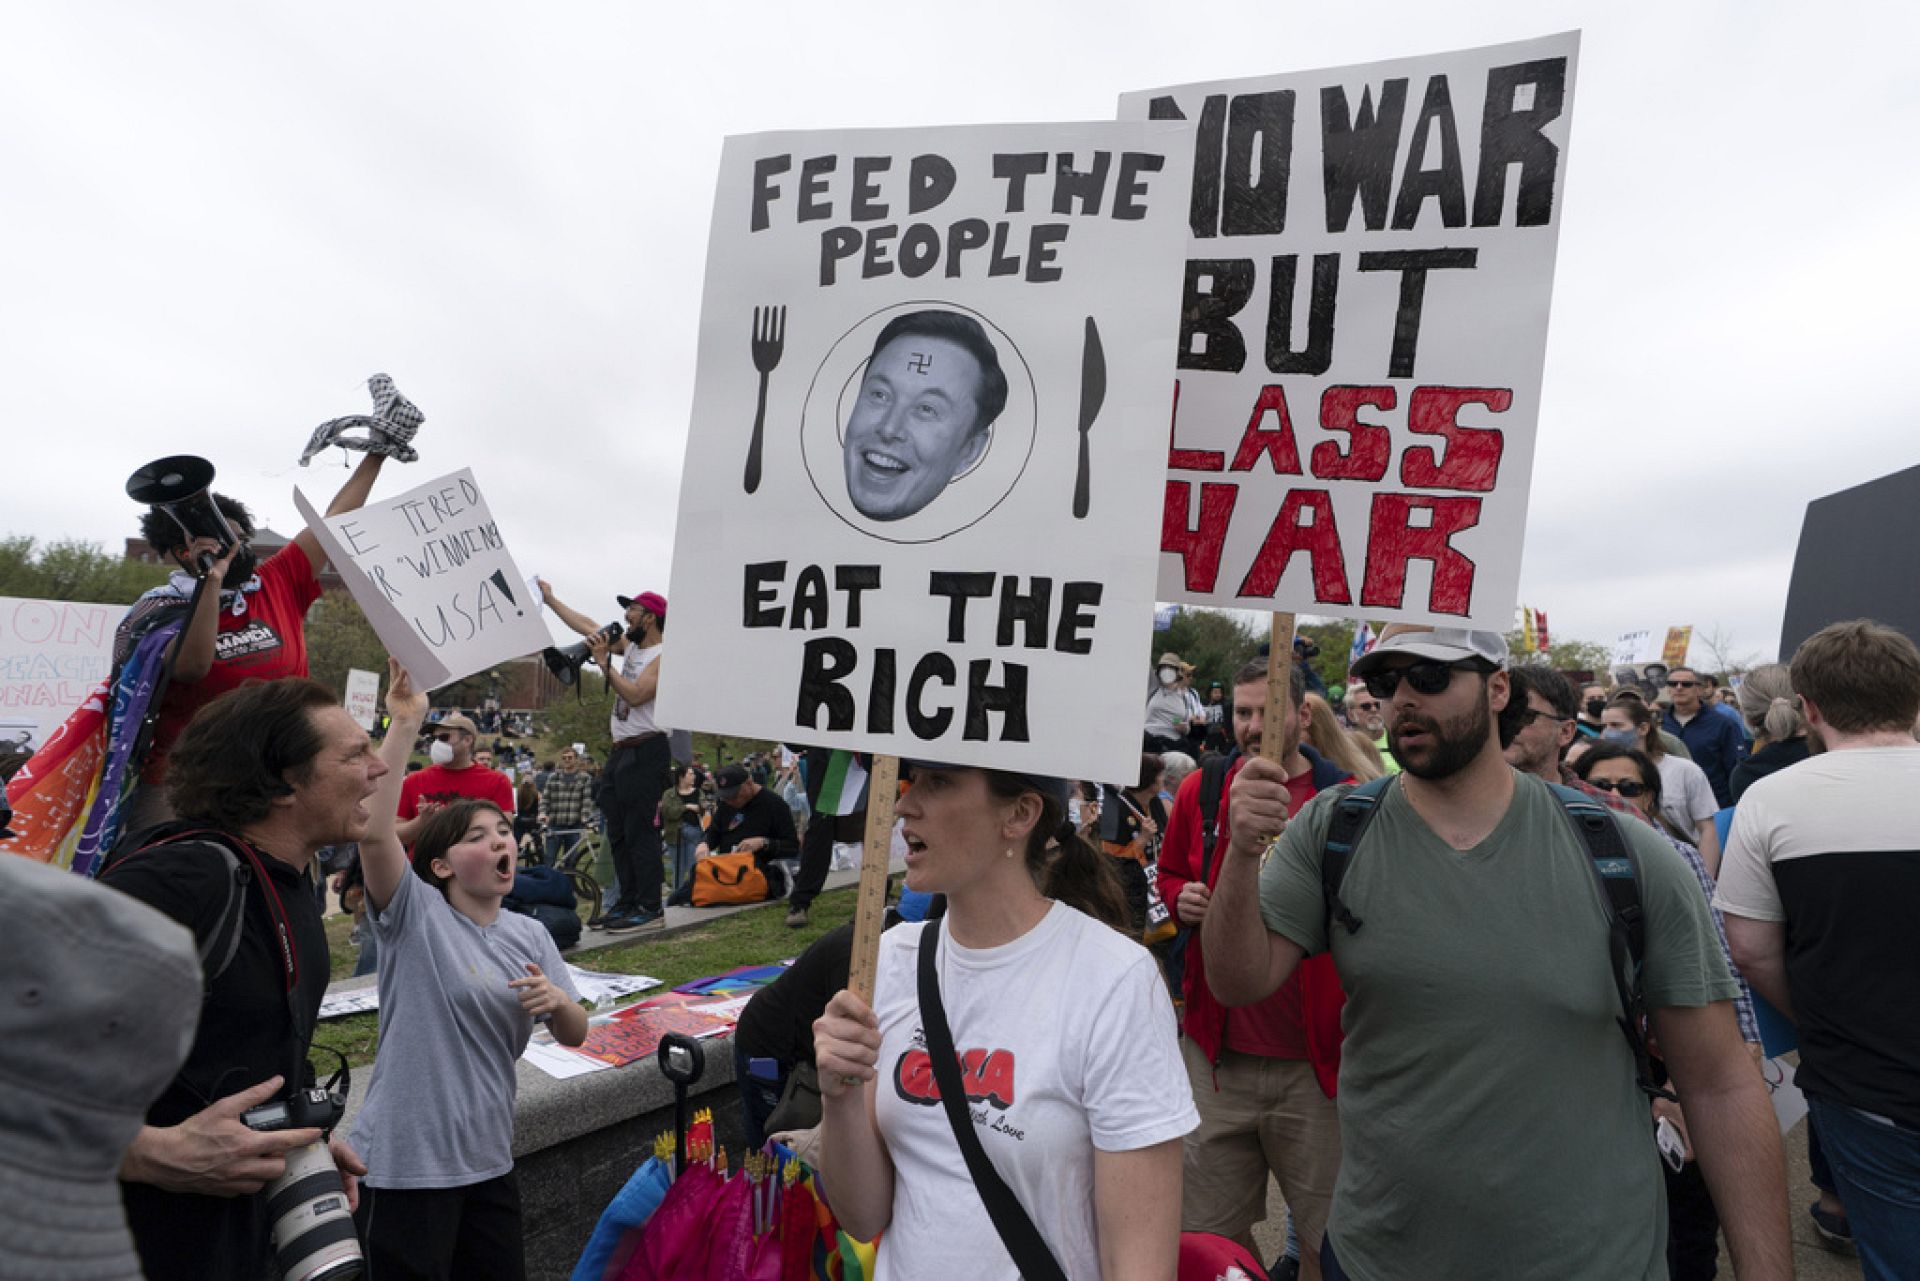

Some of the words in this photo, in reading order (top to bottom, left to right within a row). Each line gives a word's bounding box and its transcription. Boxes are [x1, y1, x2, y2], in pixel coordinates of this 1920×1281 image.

[1320, 56, 1568, 234] WAR
[750, 153, 957, 232] FEED
[992, 151, 1165, 221] THE
[819, 217, 1070, 287] PEOPLE
[1176, 247, 1479, 379] BUT
[1166, 379, 1514, 493] LASS
[339, 520, 380, 556] E
[392, 479, 479, 537] TIRED
[0, 601, 109, 649] ON
[414, 567, 524, 648] USA!
[743, 561, 881, 631] EAT
[929, 571, 1104, 655] THE
[0, 680, 102, 708] NAL
[795, 637, 1031, 744] RICH
[893, 1048, 1014, 1111] GZA
